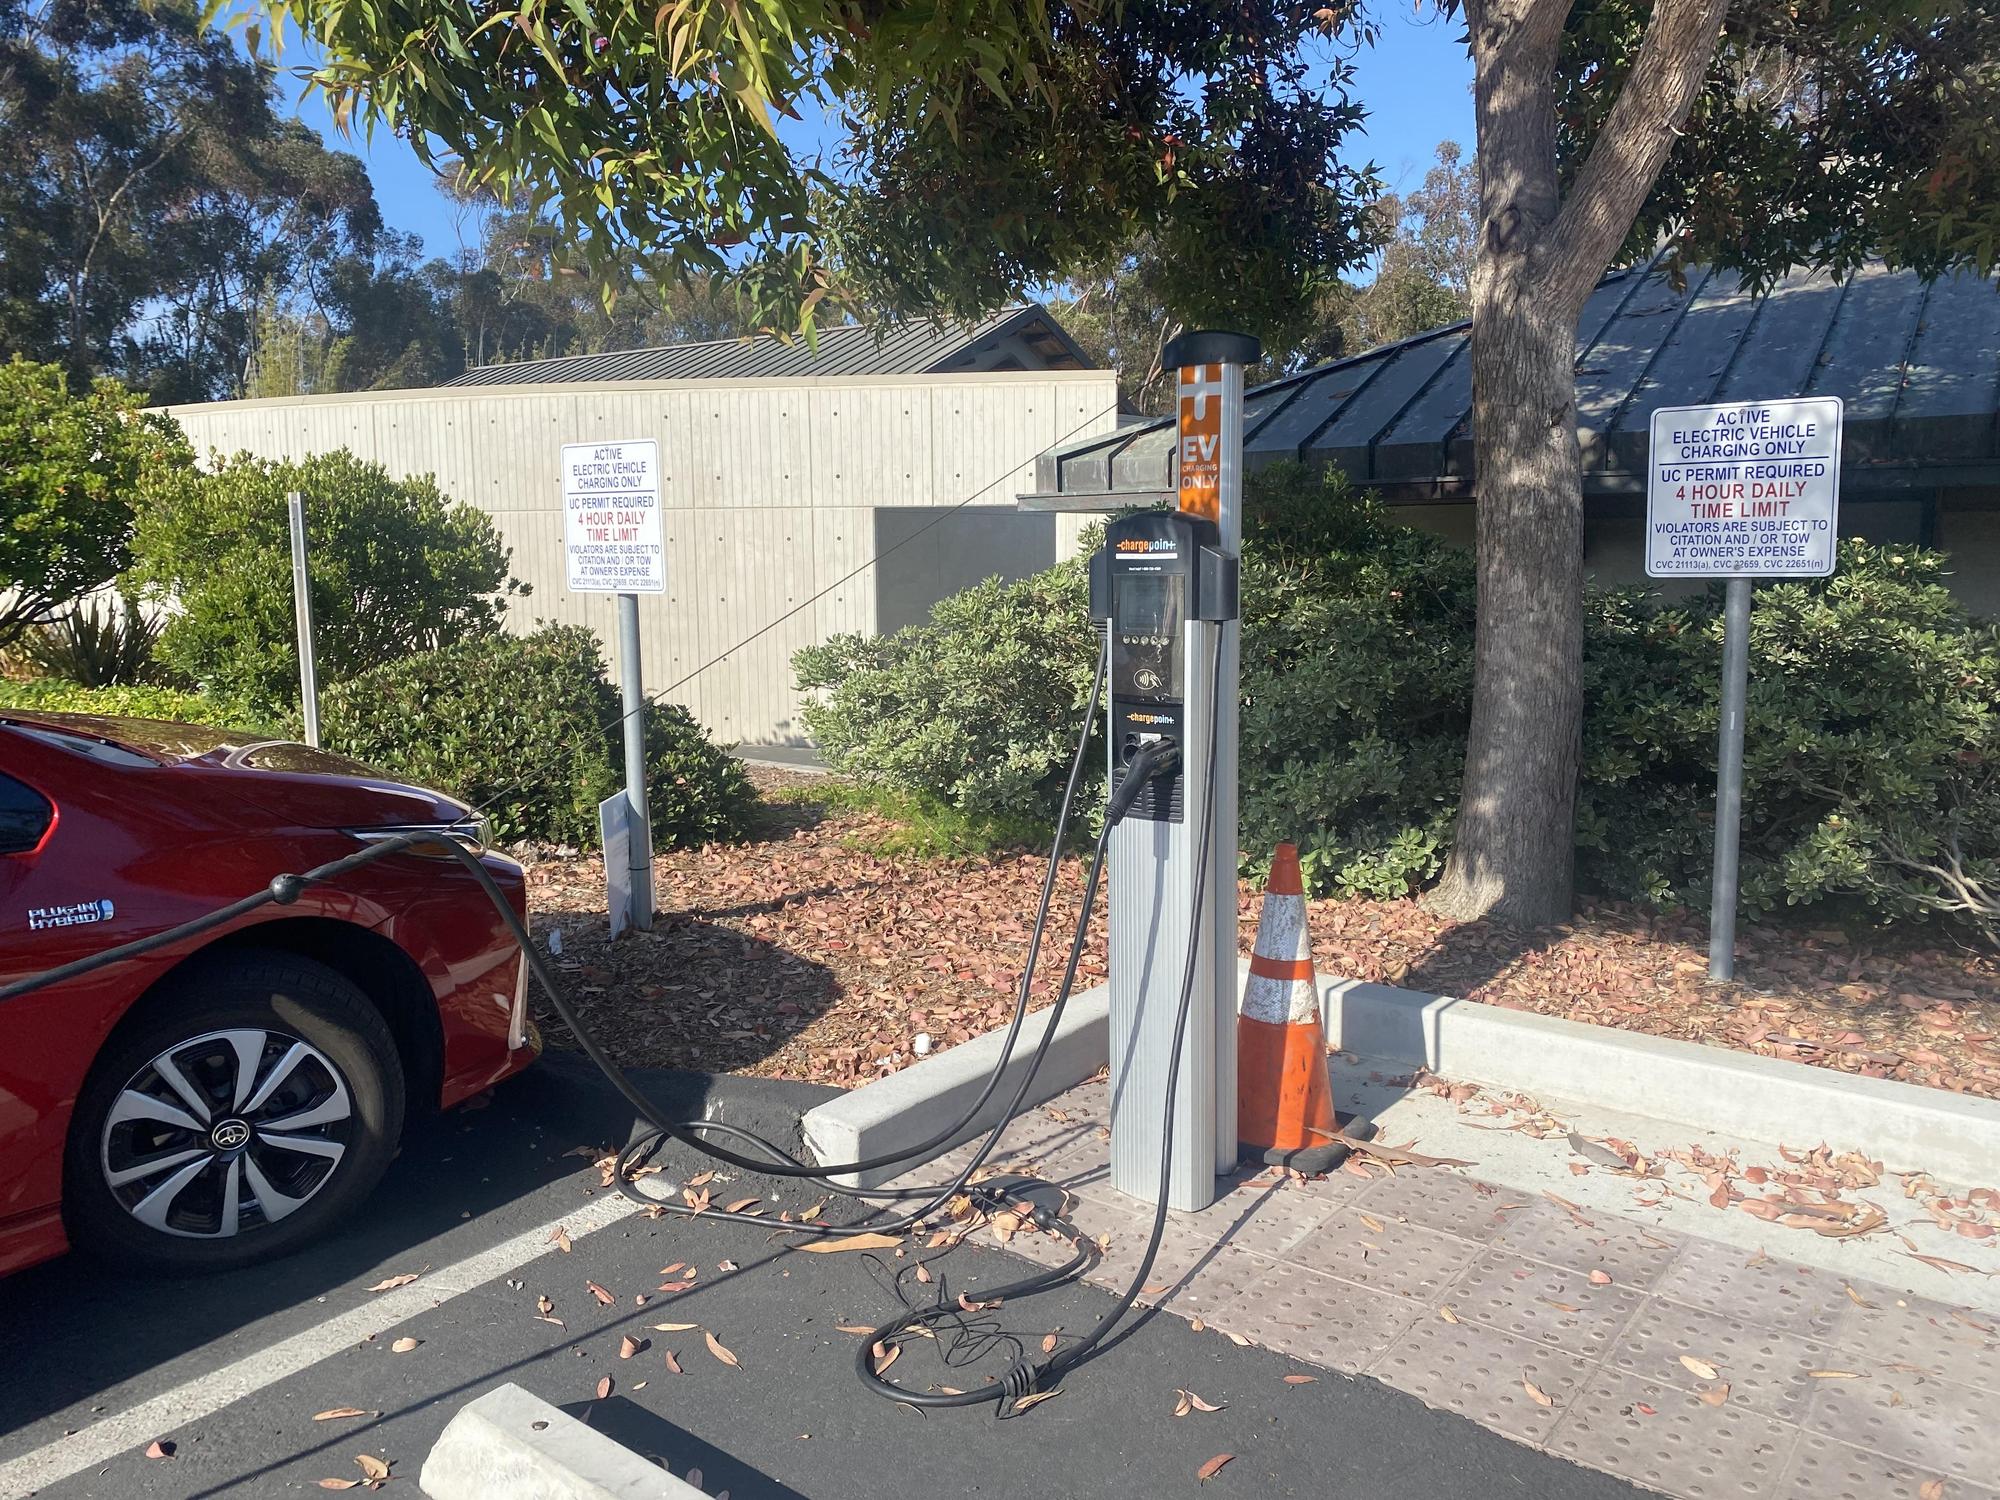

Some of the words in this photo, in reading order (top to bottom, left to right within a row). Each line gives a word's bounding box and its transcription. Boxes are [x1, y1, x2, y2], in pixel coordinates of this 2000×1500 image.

[1716, 410, 1770, 426] ACTIVE
[1673, 430, 1745, 444] ELECTRIC
[1750, 424, 1816, 439] VEHICLE
[594, 448, 622, 460] ACTIVE
[1183, 434, 1219, 462] EV
[1681, 443, 1760, 458] CHARGING
[1765, 440, 1806, 454] ONLY
[573, 463, 610, 476] ELECTRIC
[612, 461, 646, 474] VEHICLE
[1182, 464, 1217, 472] CHARGING
[1662, 470, 1680, 482] UC
[1686, 467, 1740, 482] PERMIT
[1744, 464, 1824, 479] REQUIRED
[578, 476, 619, 489] CHARGING
[622, 476, 642, 487] ONLY
[1182, 475, 1218, 489] ONLY
[1676, 486, 1686, 500] 4
[1692, 484, 1744, 500] HOUR
[1752, 481, 1807, 498] DAILY
[570, 498, 580, 510] UC
[582, 497, 610, 509] PERMIT
[612, 496, 654, 508] REQUIRED
[1690, 503, 1733, 518] TIME
[1740, 501, 1790, 518] LIMIT
[578, 512, 584, 526] 4
[586, 512, 613, 525] HOUR
[618, 511, 646, 525] DAILY
[1655, 522, 1720, 533] VIOLATORS
[1722, 522, 1747, 532] ARE
[1751, 520, 1808, 532] SUBJECT
[1812, 520, 1828, 530] TO
[586, 528, 609, 542] TIME
[613, 528, 638, 542] LIMIT
[1670, 534, 1722, 546] CITATION
[1725, 534, 1750, 544] AND
[1760, 534, 1778, 544] OR
[1782, 533, 1810, 544] TOW
[570, 545, 603, 554] VIOLATORS
[605, 545, 618, 554] ARE
[620, 545, 648, 554] SUBJECT
[651, 545, 659, 554] TO
[1673, 548, 1687, 558] AT
[1690, 546, 1744, 557] OWNER'S
[1749, 546, 1805, 556] EXPENSE
[578, 556, 605, 565] CITATION
[607, 556, 620, 565] AND
[625, 556, 634, 565] OR
[636, 556, 651, 565] TOW
[1656, 560, 1674, 569] CVC
[1764, 560, 1783, 568] CVC
[581, 567, 588, 575] AT
[589, 567, 618, 576] OWNER'S
[620, 567, 650, 576] EXPENSE
[28, 902, 96, 918] PLUG-IN
[29, 914, 97, 930] HYBRID
